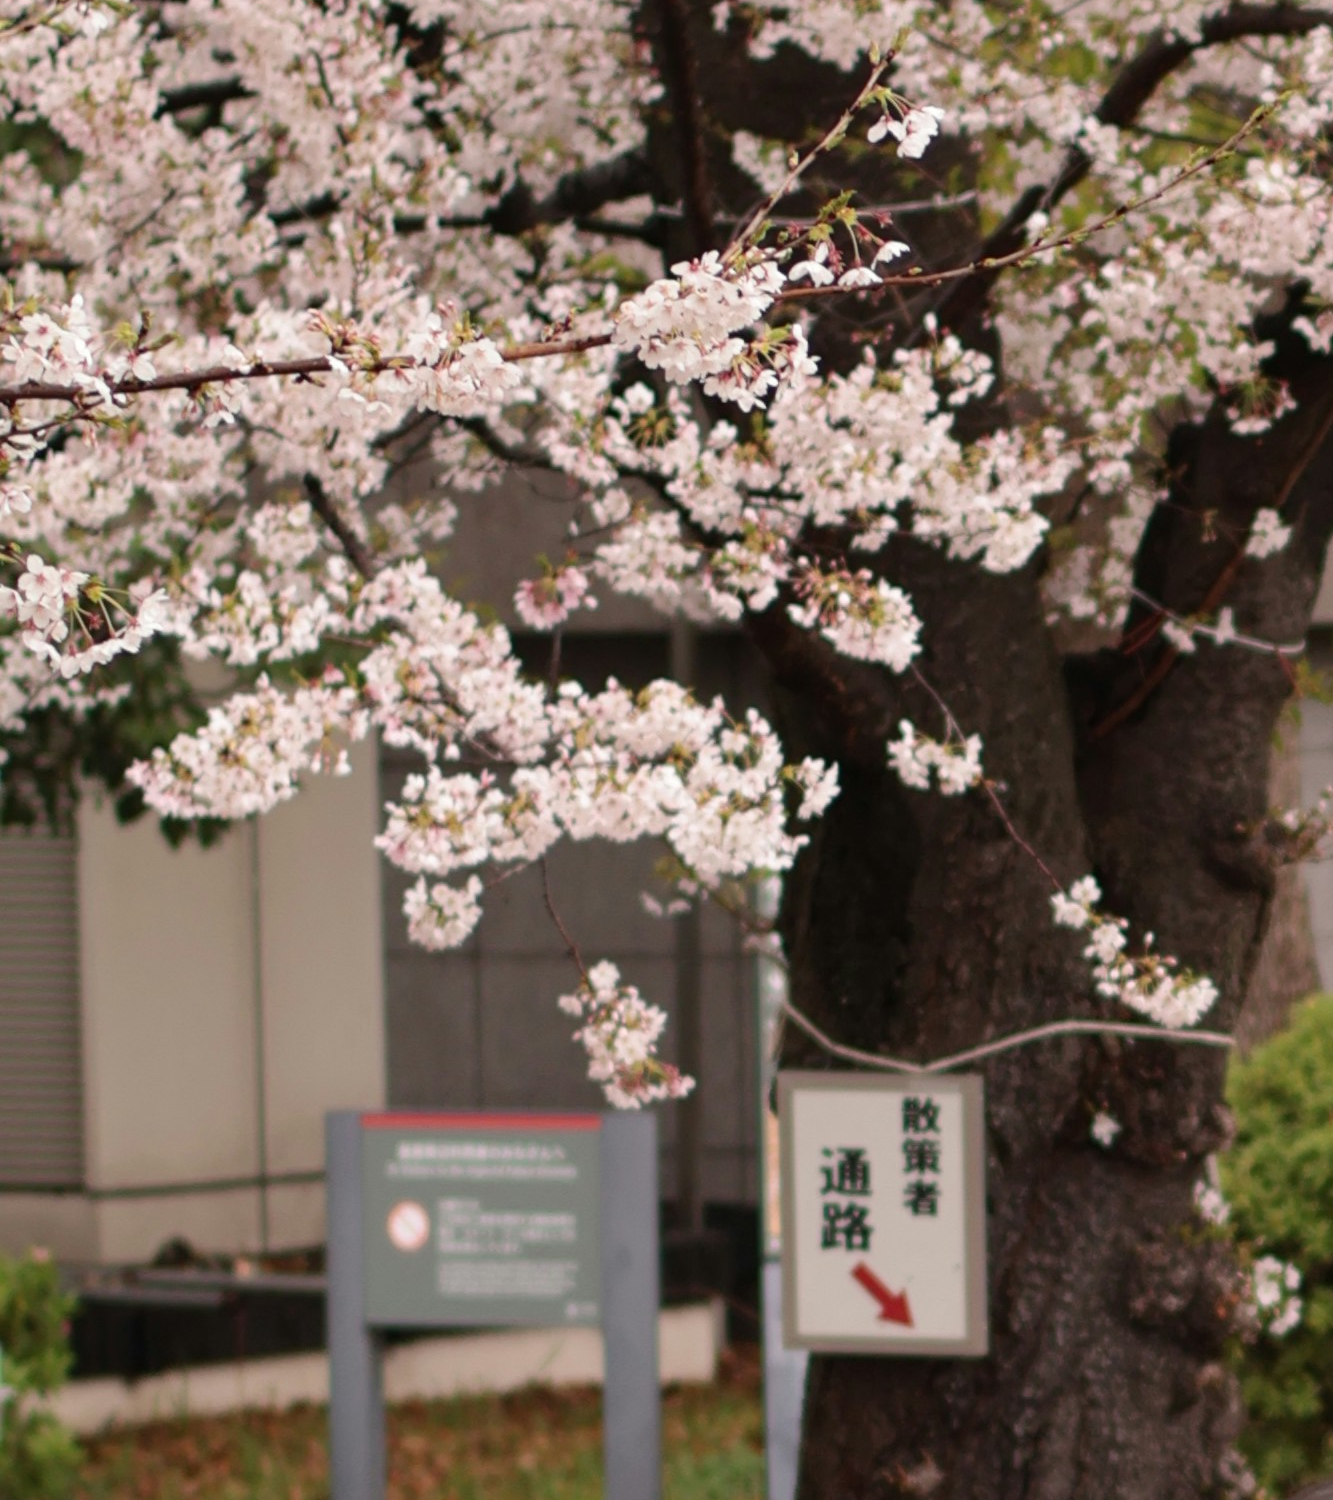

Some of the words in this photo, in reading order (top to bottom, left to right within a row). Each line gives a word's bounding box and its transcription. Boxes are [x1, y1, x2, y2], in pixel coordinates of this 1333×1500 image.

[819, 1146, 875, 1253] 通路
[901, 1096, 942, 1218] 散策者
